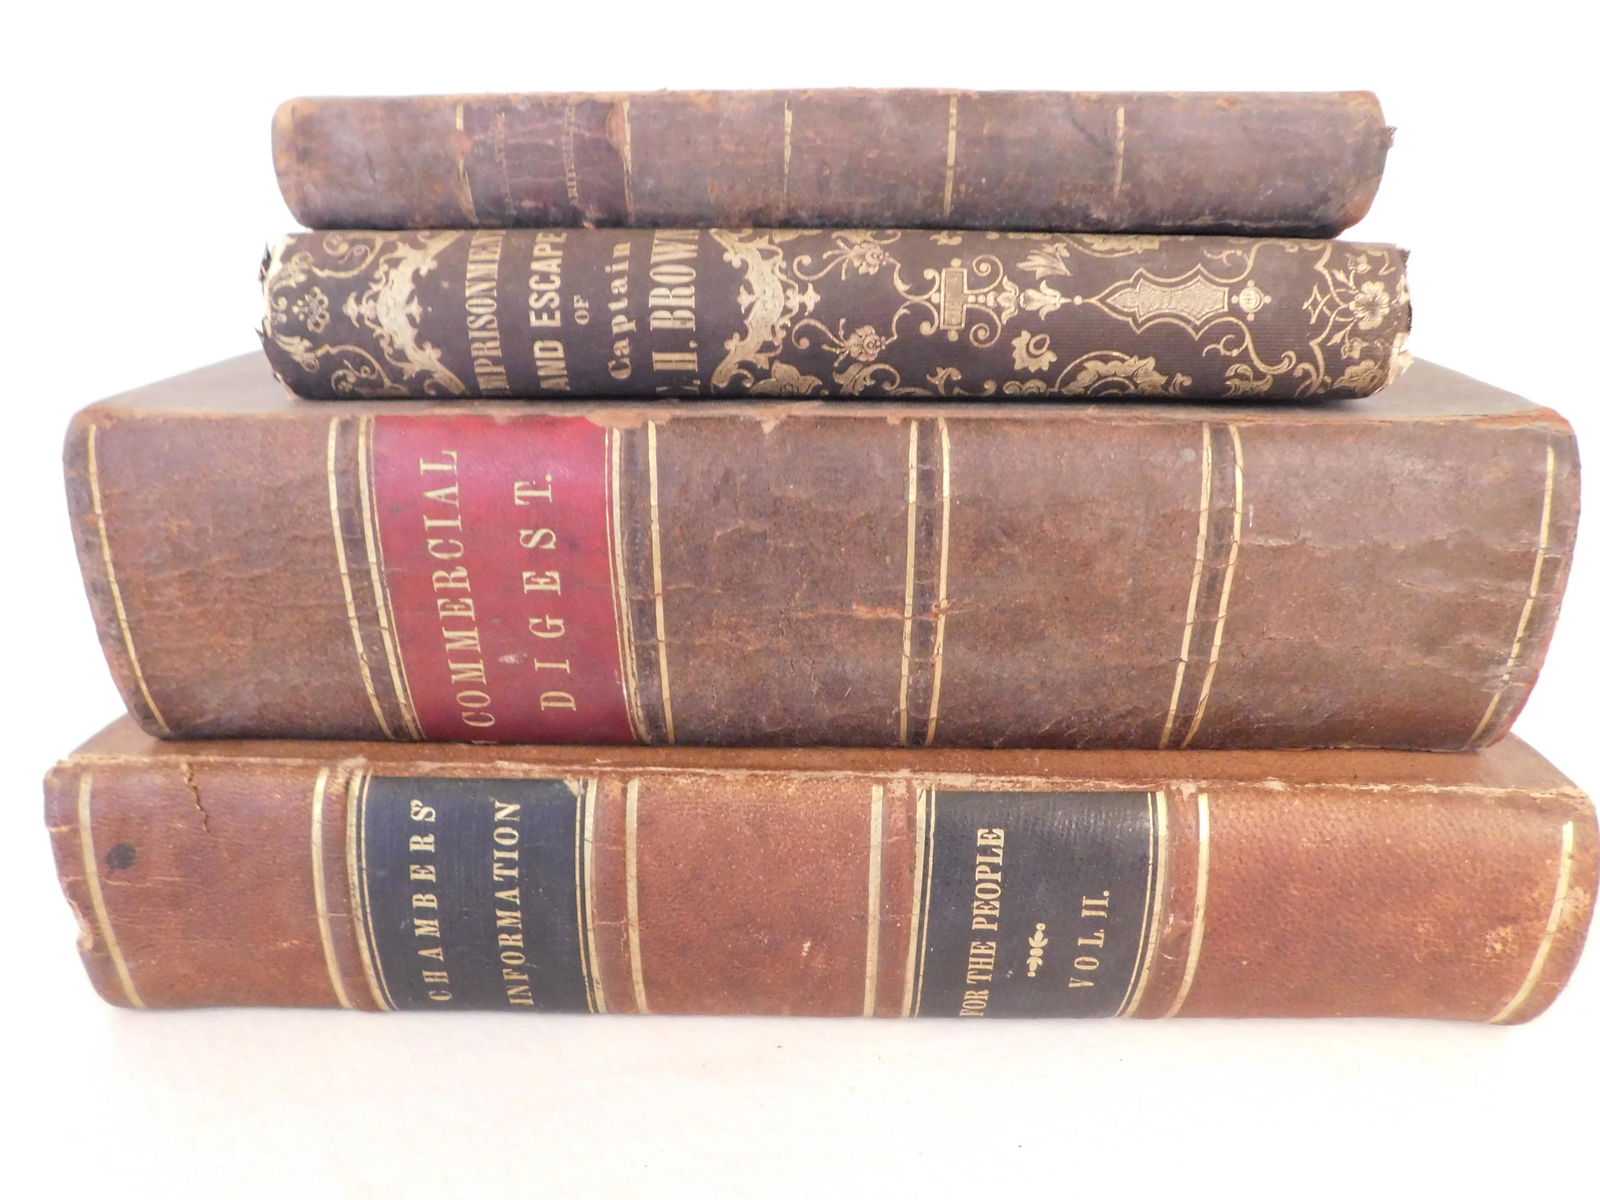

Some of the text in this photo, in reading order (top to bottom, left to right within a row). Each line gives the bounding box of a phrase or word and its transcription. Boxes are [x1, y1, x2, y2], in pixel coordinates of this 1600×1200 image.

[528, 231, 570, 390] AND ESCAPE
[573, 294, 589, 325] OF
[604, 241, 637, 379] Captain
[652, 340, 698, 372] H.
[419, 450, 496, 727] COMMERCIAL
[514, 473, 576, 712] DIGEST.
[493, 800, 534, 1006] INFORMATION
[959, 828, 1005, 1017] FOR THE PEOPLE
[1081, 890, 1110, 918] II.
